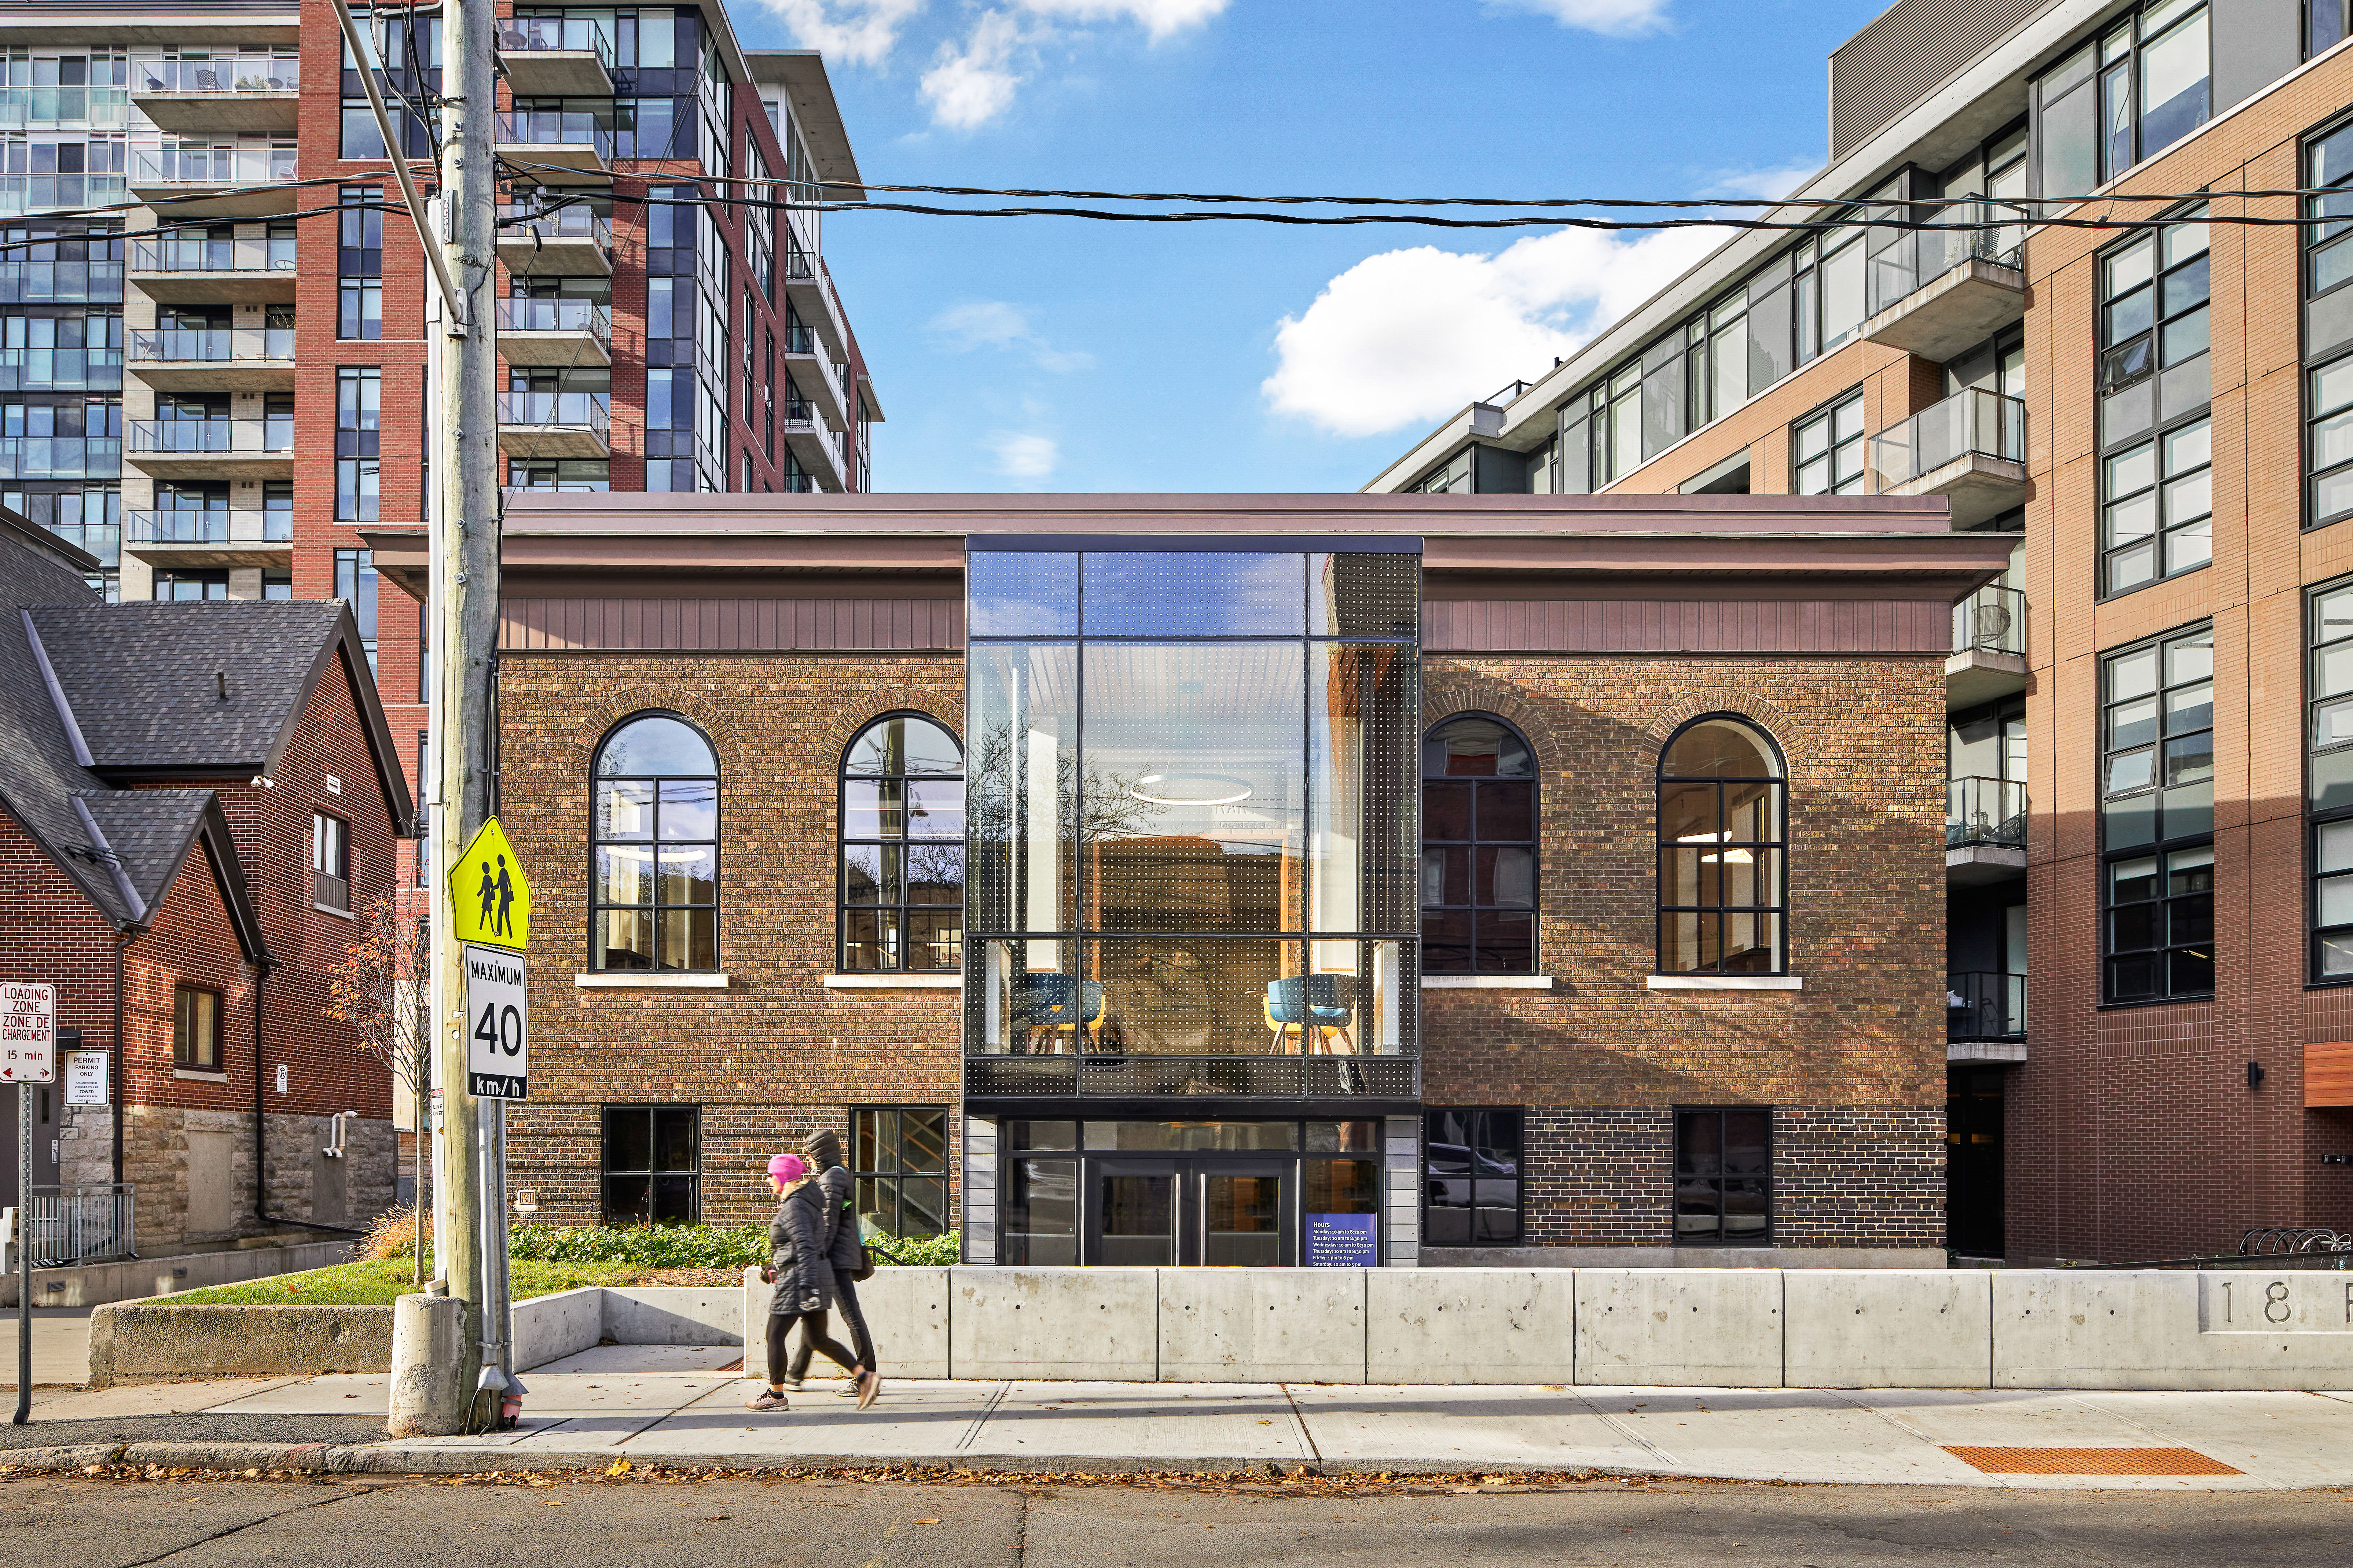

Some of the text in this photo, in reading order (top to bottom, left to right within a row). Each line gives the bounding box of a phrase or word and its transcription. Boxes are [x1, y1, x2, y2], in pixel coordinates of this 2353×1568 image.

[471, 960, 521, 987] MAXIMUM
[4, 987, 48, 1001] LOADING
[12, 1001, 40, 1013] ZONE
[3, 1016, 49, 1028] ZONE DE
[3, 1029, 50, 1041] CHARGEMENT
[474, 1002, 521, 1057] 40
[8, 1050, 43, 1060] 15 min
[477, 1075, 520, 1097] km/h
[2222, 1282, 2292, 1324] 18
